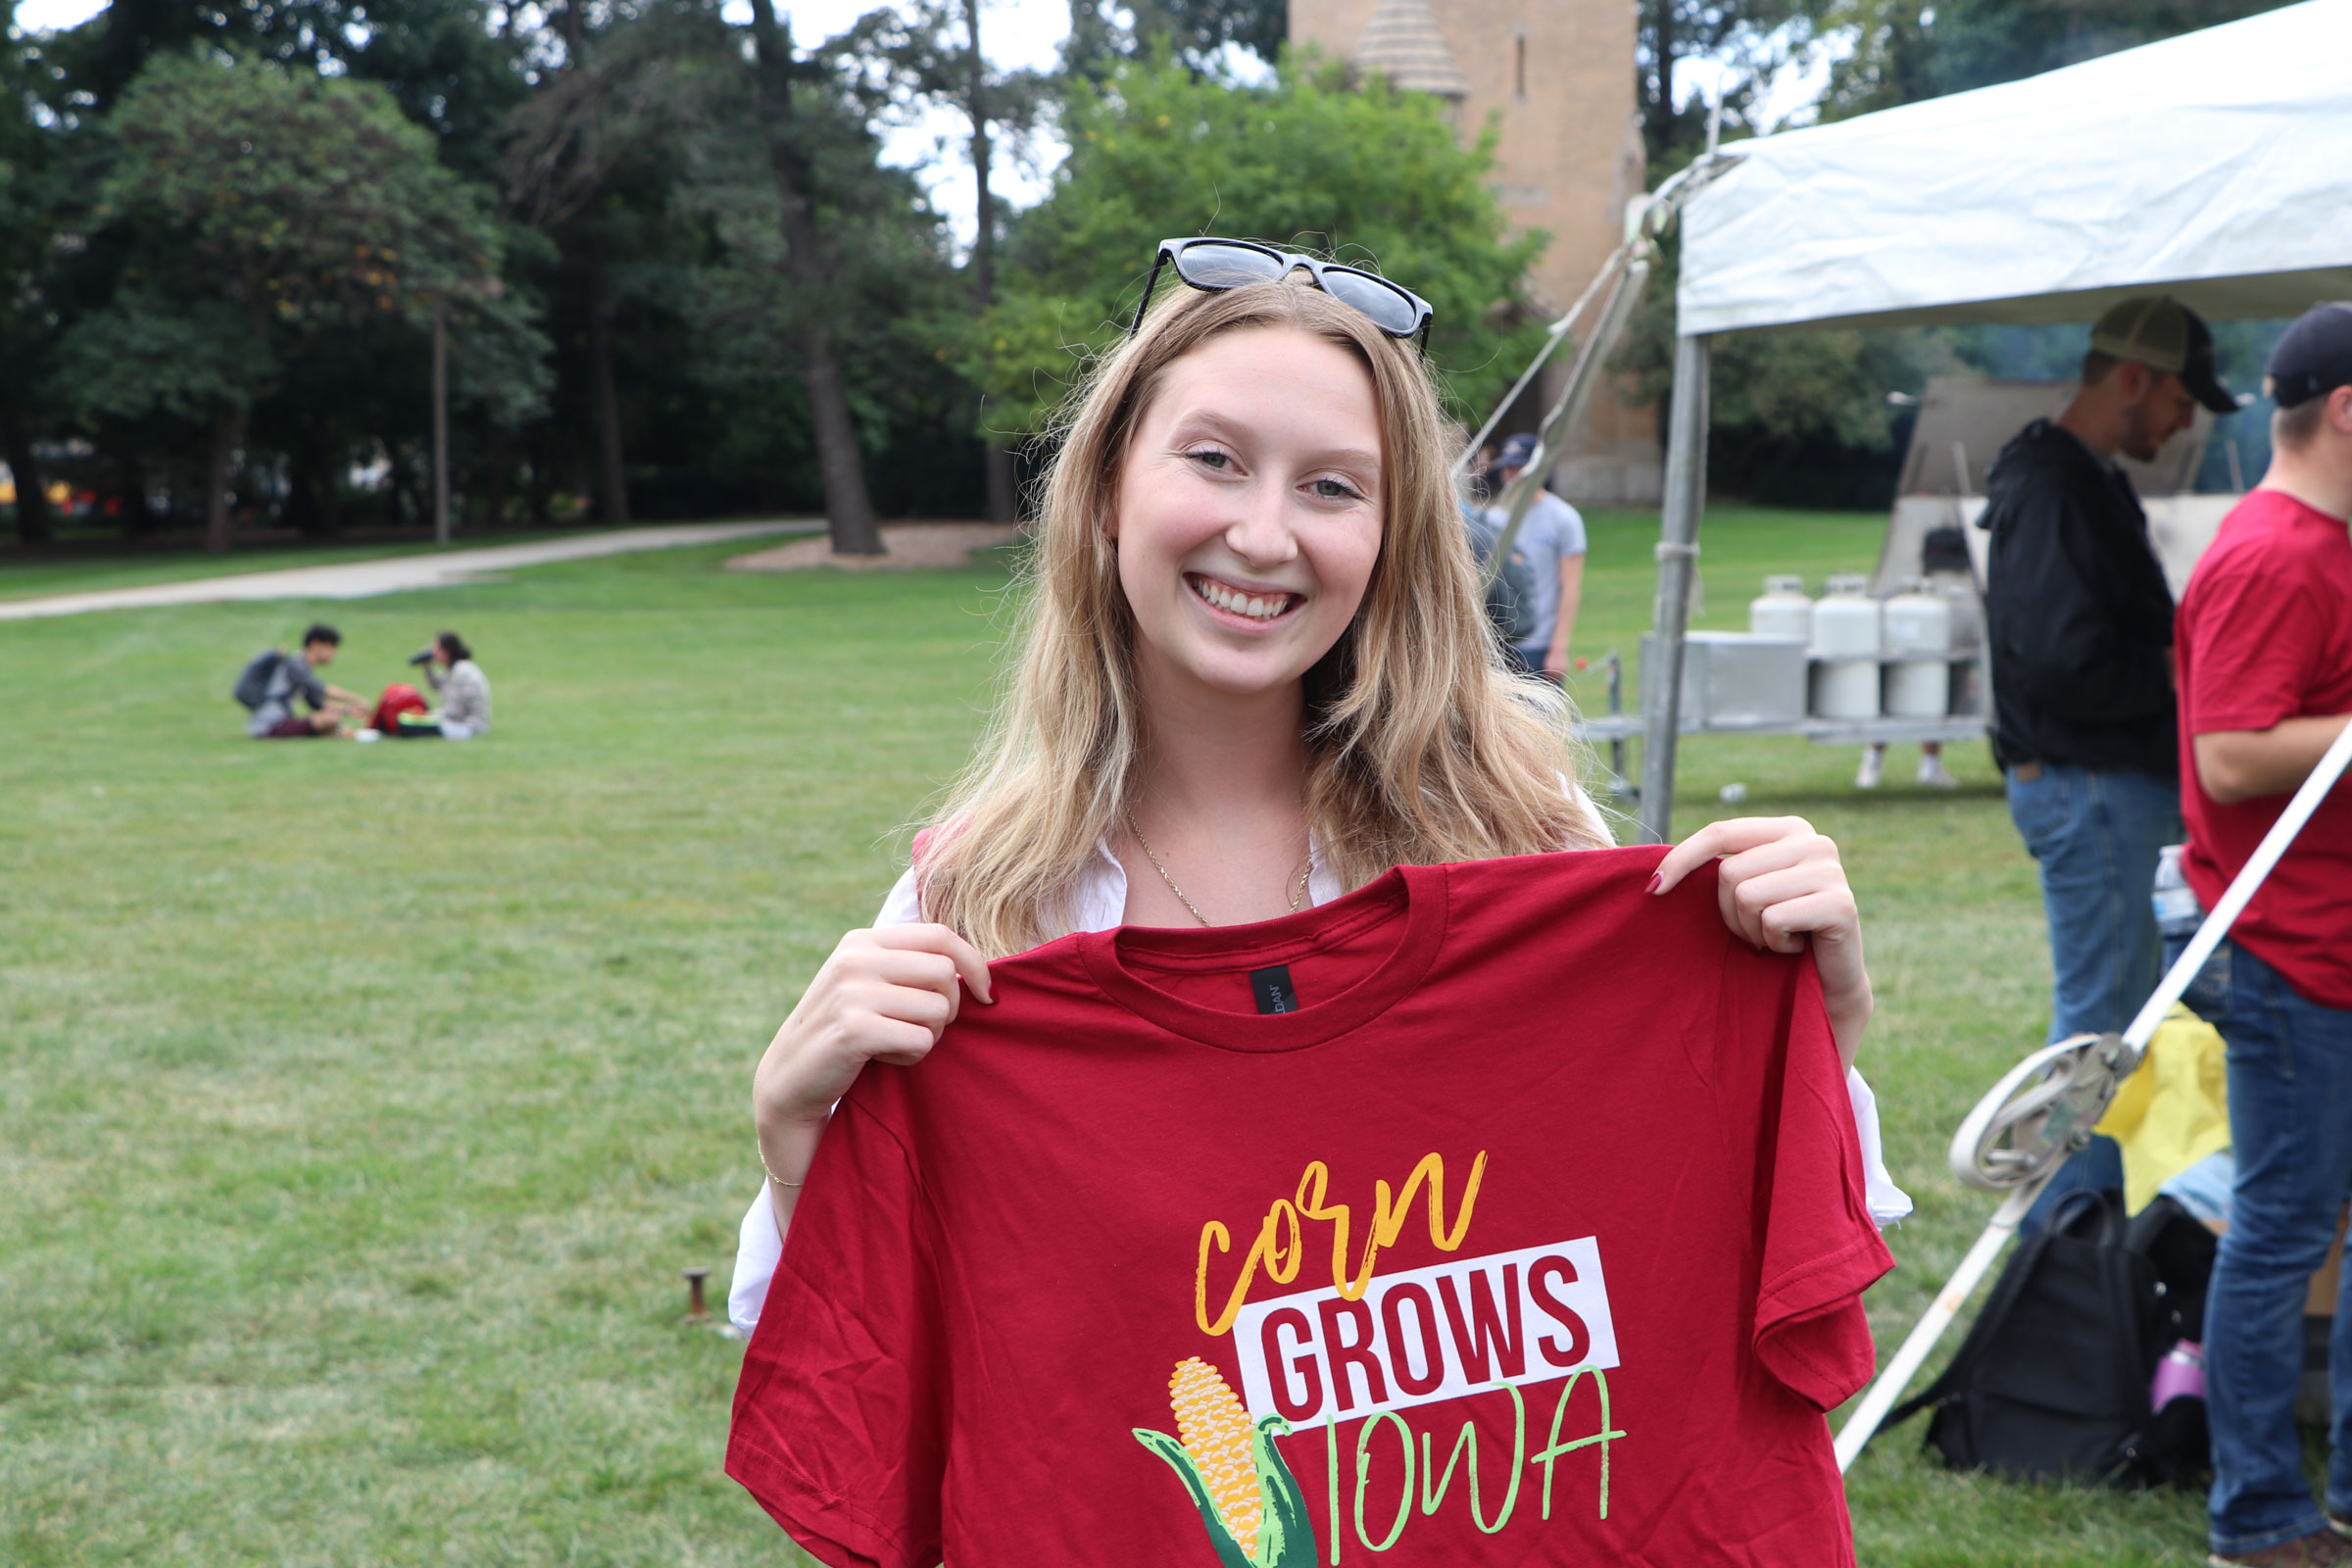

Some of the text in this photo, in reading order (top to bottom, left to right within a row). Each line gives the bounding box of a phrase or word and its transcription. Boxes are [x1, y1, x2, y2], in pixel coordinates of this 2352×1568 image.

[1269, 986, 1285, 1013] DAN
[1196, 1151, 1488, 1336] corn
[1260, 1254, 1591, 1422] GROWS
[1326, 1364, 1627, 1566] IOWA
